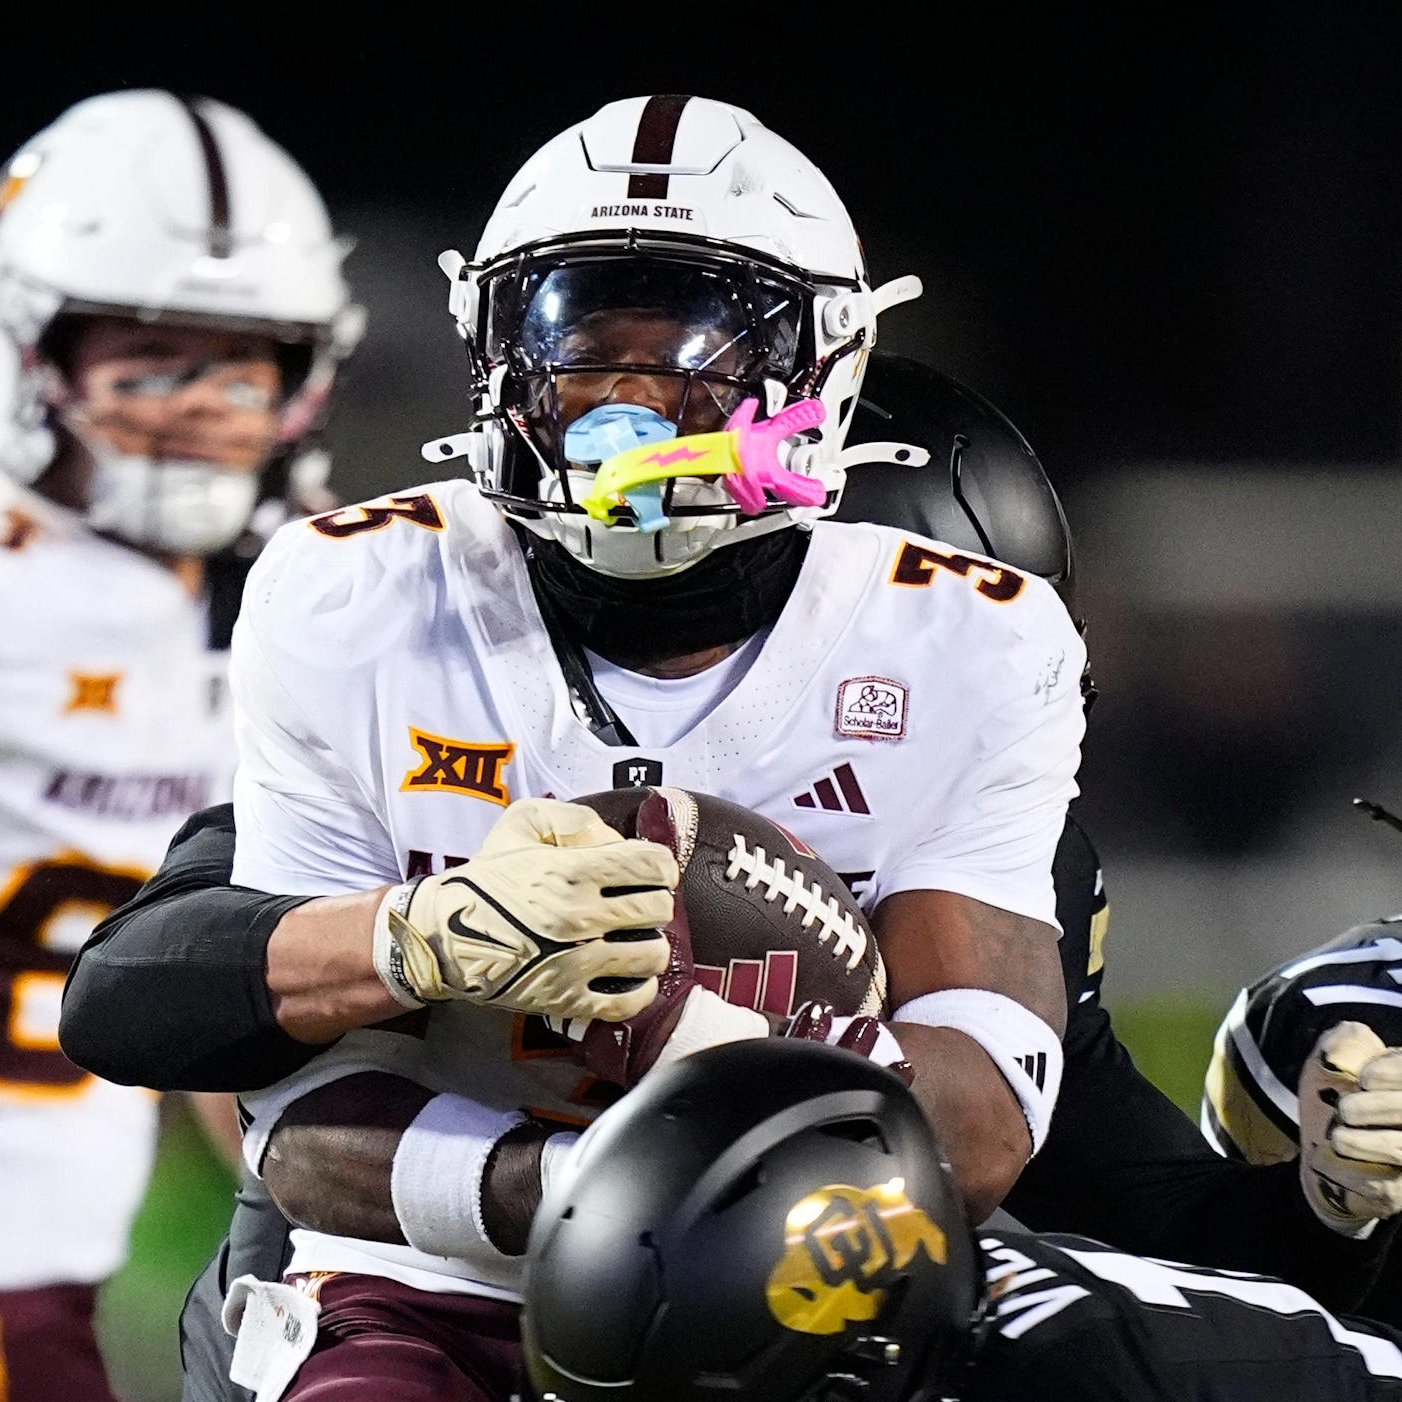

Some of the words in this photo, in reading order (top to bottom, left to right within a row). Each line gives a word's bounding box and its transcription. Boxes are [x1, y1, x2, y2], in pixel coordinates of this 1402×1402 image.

[590, 205, 649, 218] ARIZONA
[653, 205, 694, 221] STATE
[307, 493, 447, 541] 3
[889, 539, 1029, 604] 3
[407, 733, 513, 803] XII
[628, 766, 648, 782] PT
